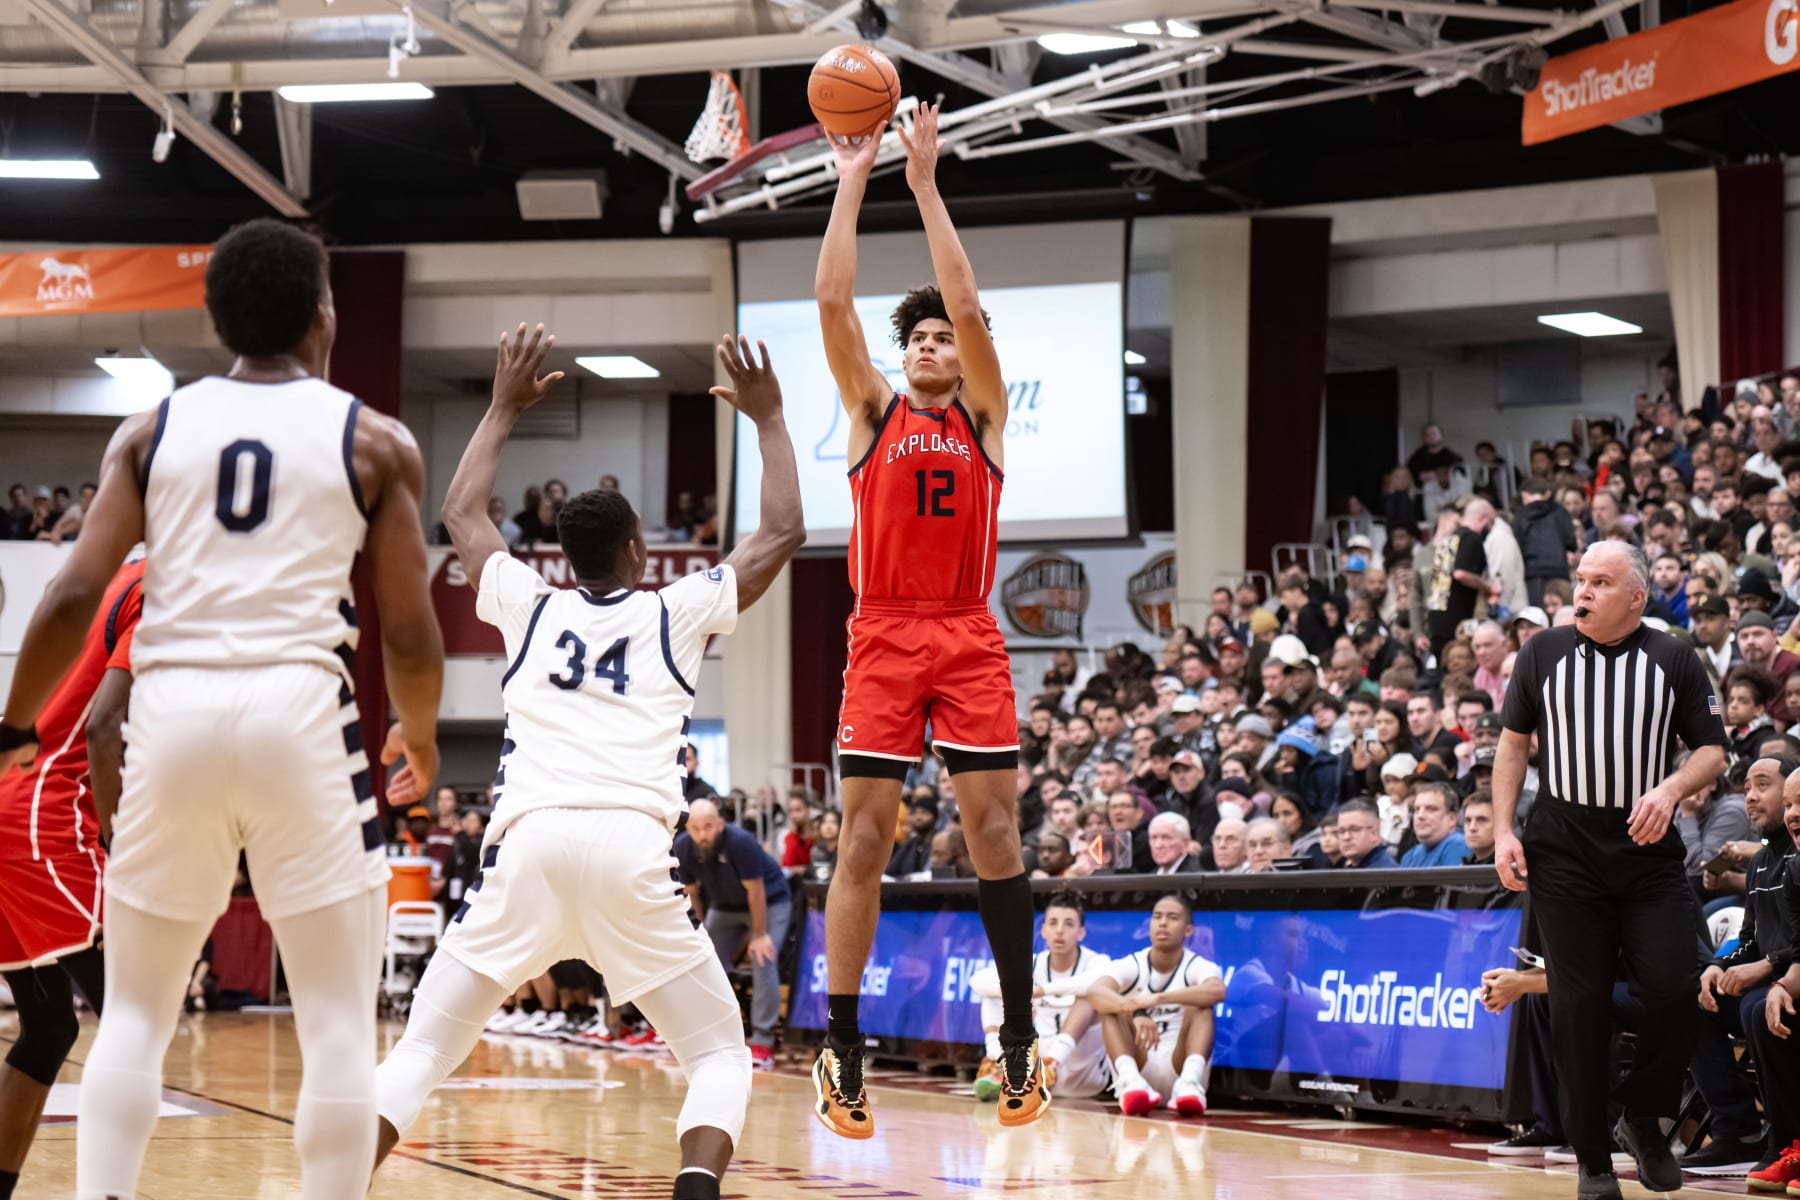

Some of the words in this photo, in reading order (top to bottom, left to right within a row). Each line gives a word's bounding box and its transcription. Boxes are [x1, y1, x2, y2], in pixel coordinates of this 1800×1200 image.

[1542, 59, 1656, 117] ShotTracker
[36, 283, 95, 302] MGM
[215, 438, 274, 533] 0
[915, 470, 955, 516] 12
[548, 629, 630, 696] 34
[841, 725, 855, 743] C
[1317, 969, 1482, 1029] ShotTracker
